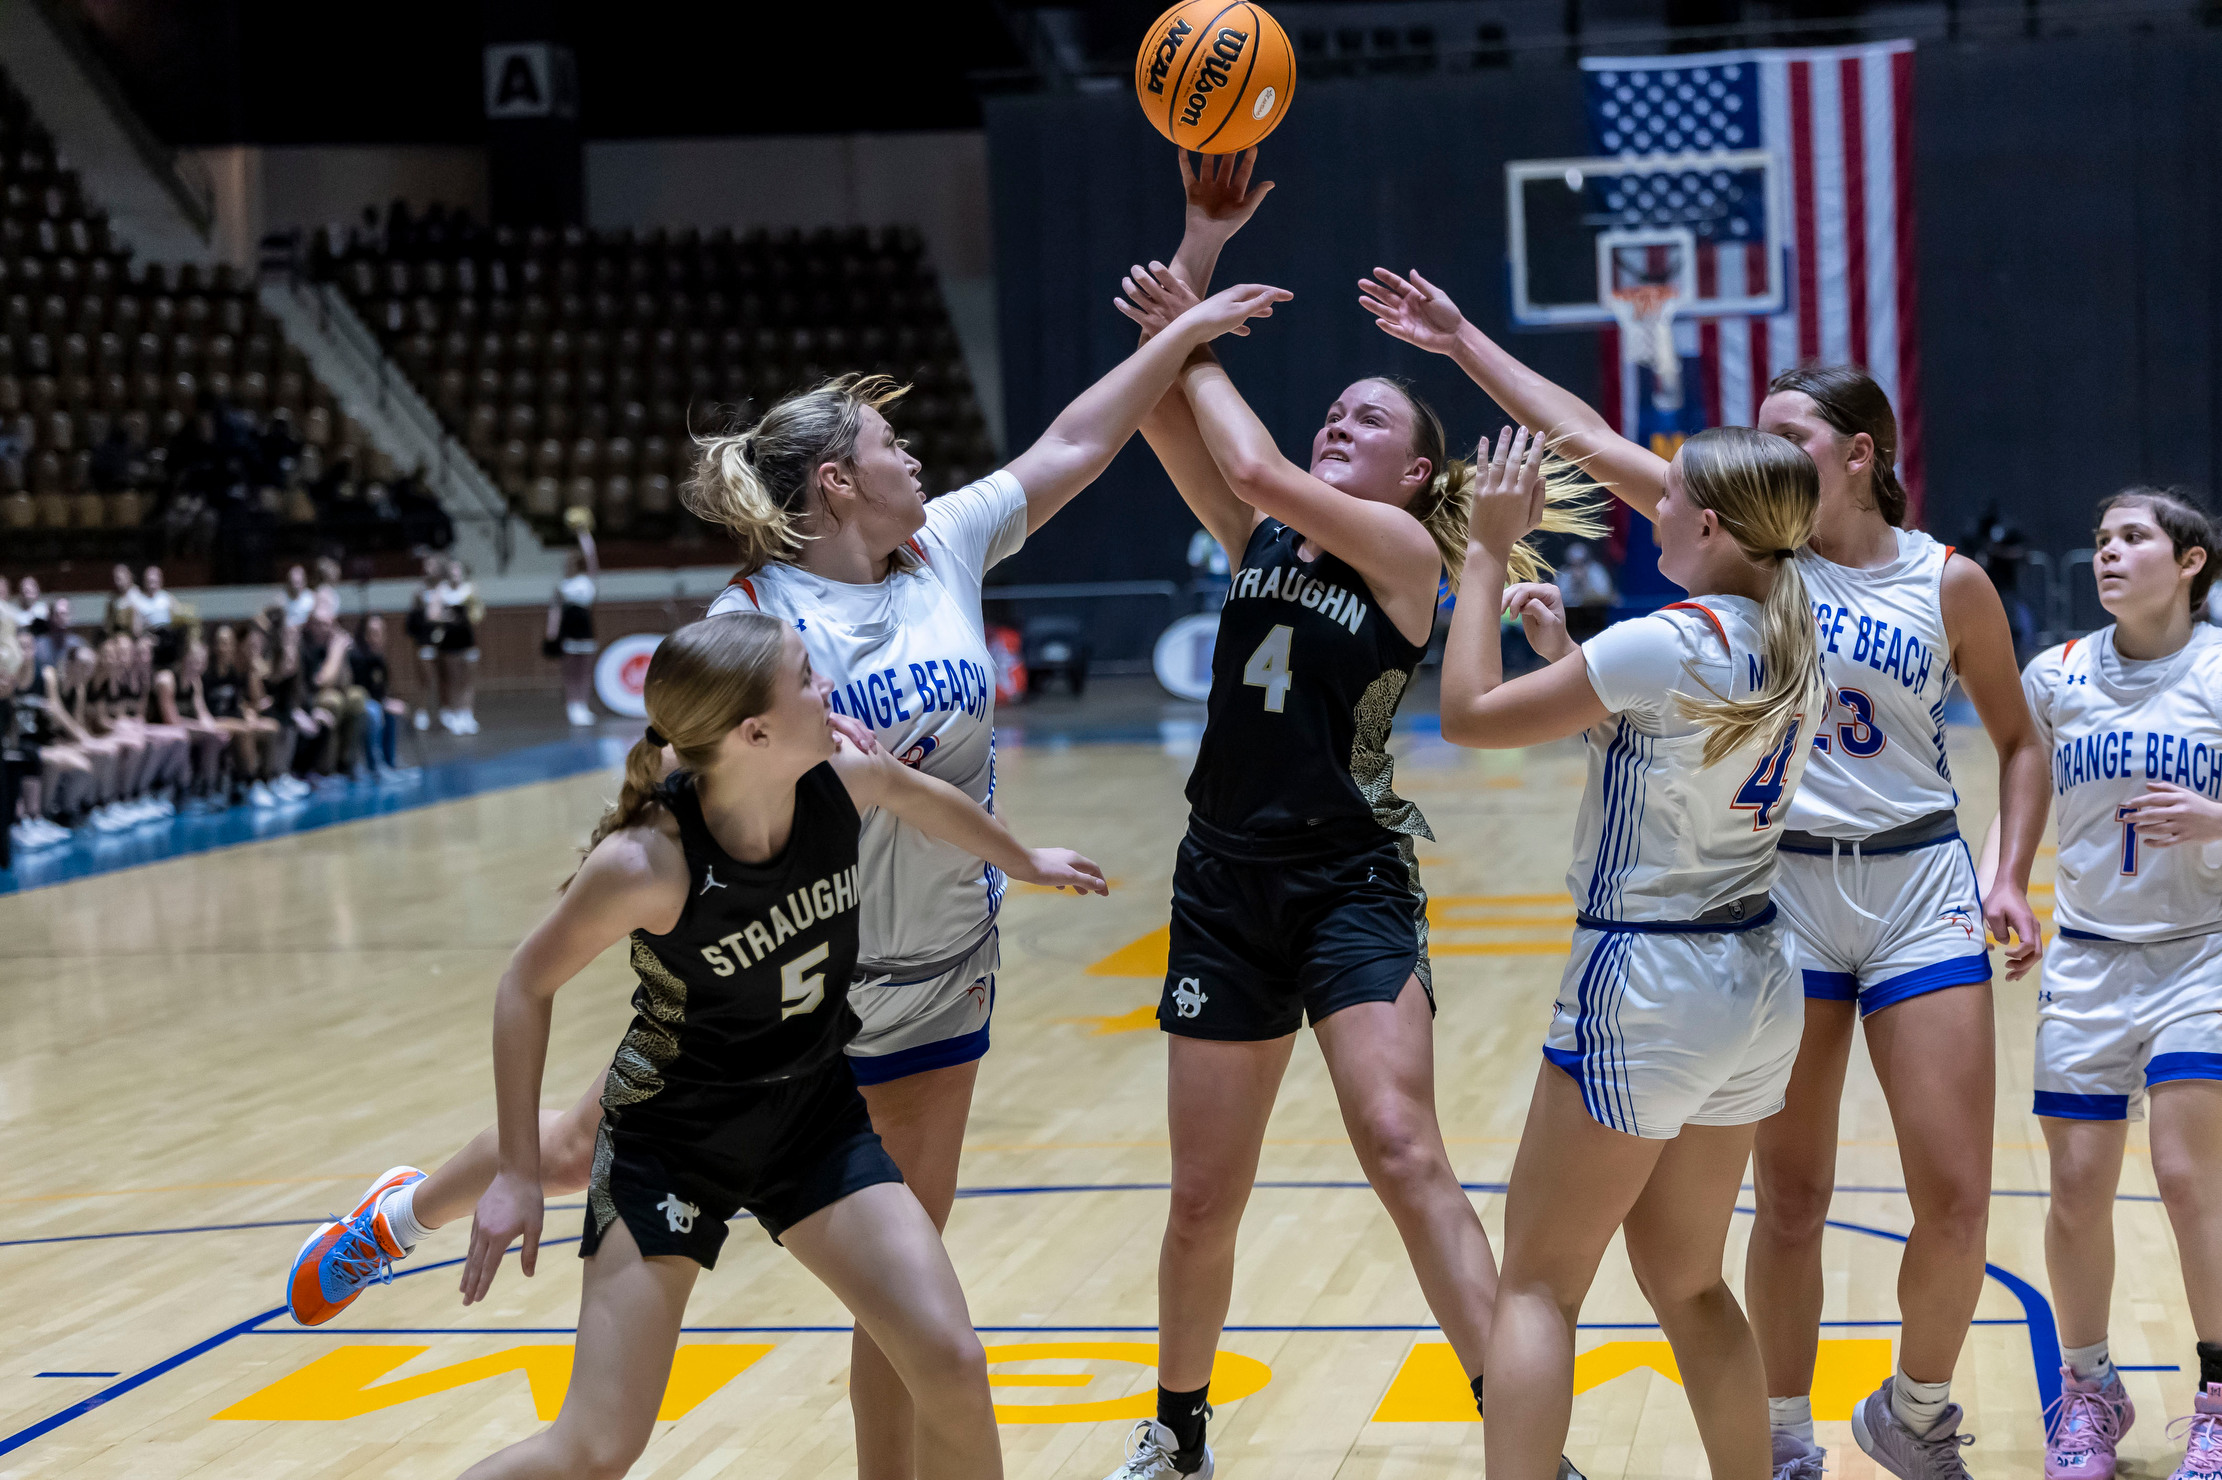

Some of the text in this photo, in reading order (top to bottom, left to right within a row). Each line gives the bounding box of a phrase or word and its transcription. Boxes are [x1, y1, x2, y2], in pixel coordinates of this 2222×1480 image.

[498, 54, 540, 105] A
[1148, 18, 1193, 95] NCAA
[1181, 28, 1249, 127] Wilson
[1222, 566, 1367, 636] TRAUGHN
[831, 658, 987, 729] ANGE BEACH
[1243, 624, 1294, 714] 4
[1853, 615, 1933, 696] BEACH
[1730, 713, 1805, 832] 4
[2056, 731, 2222, 799] ORANGE BEACH
[780, 941, 830, 1022] 5
